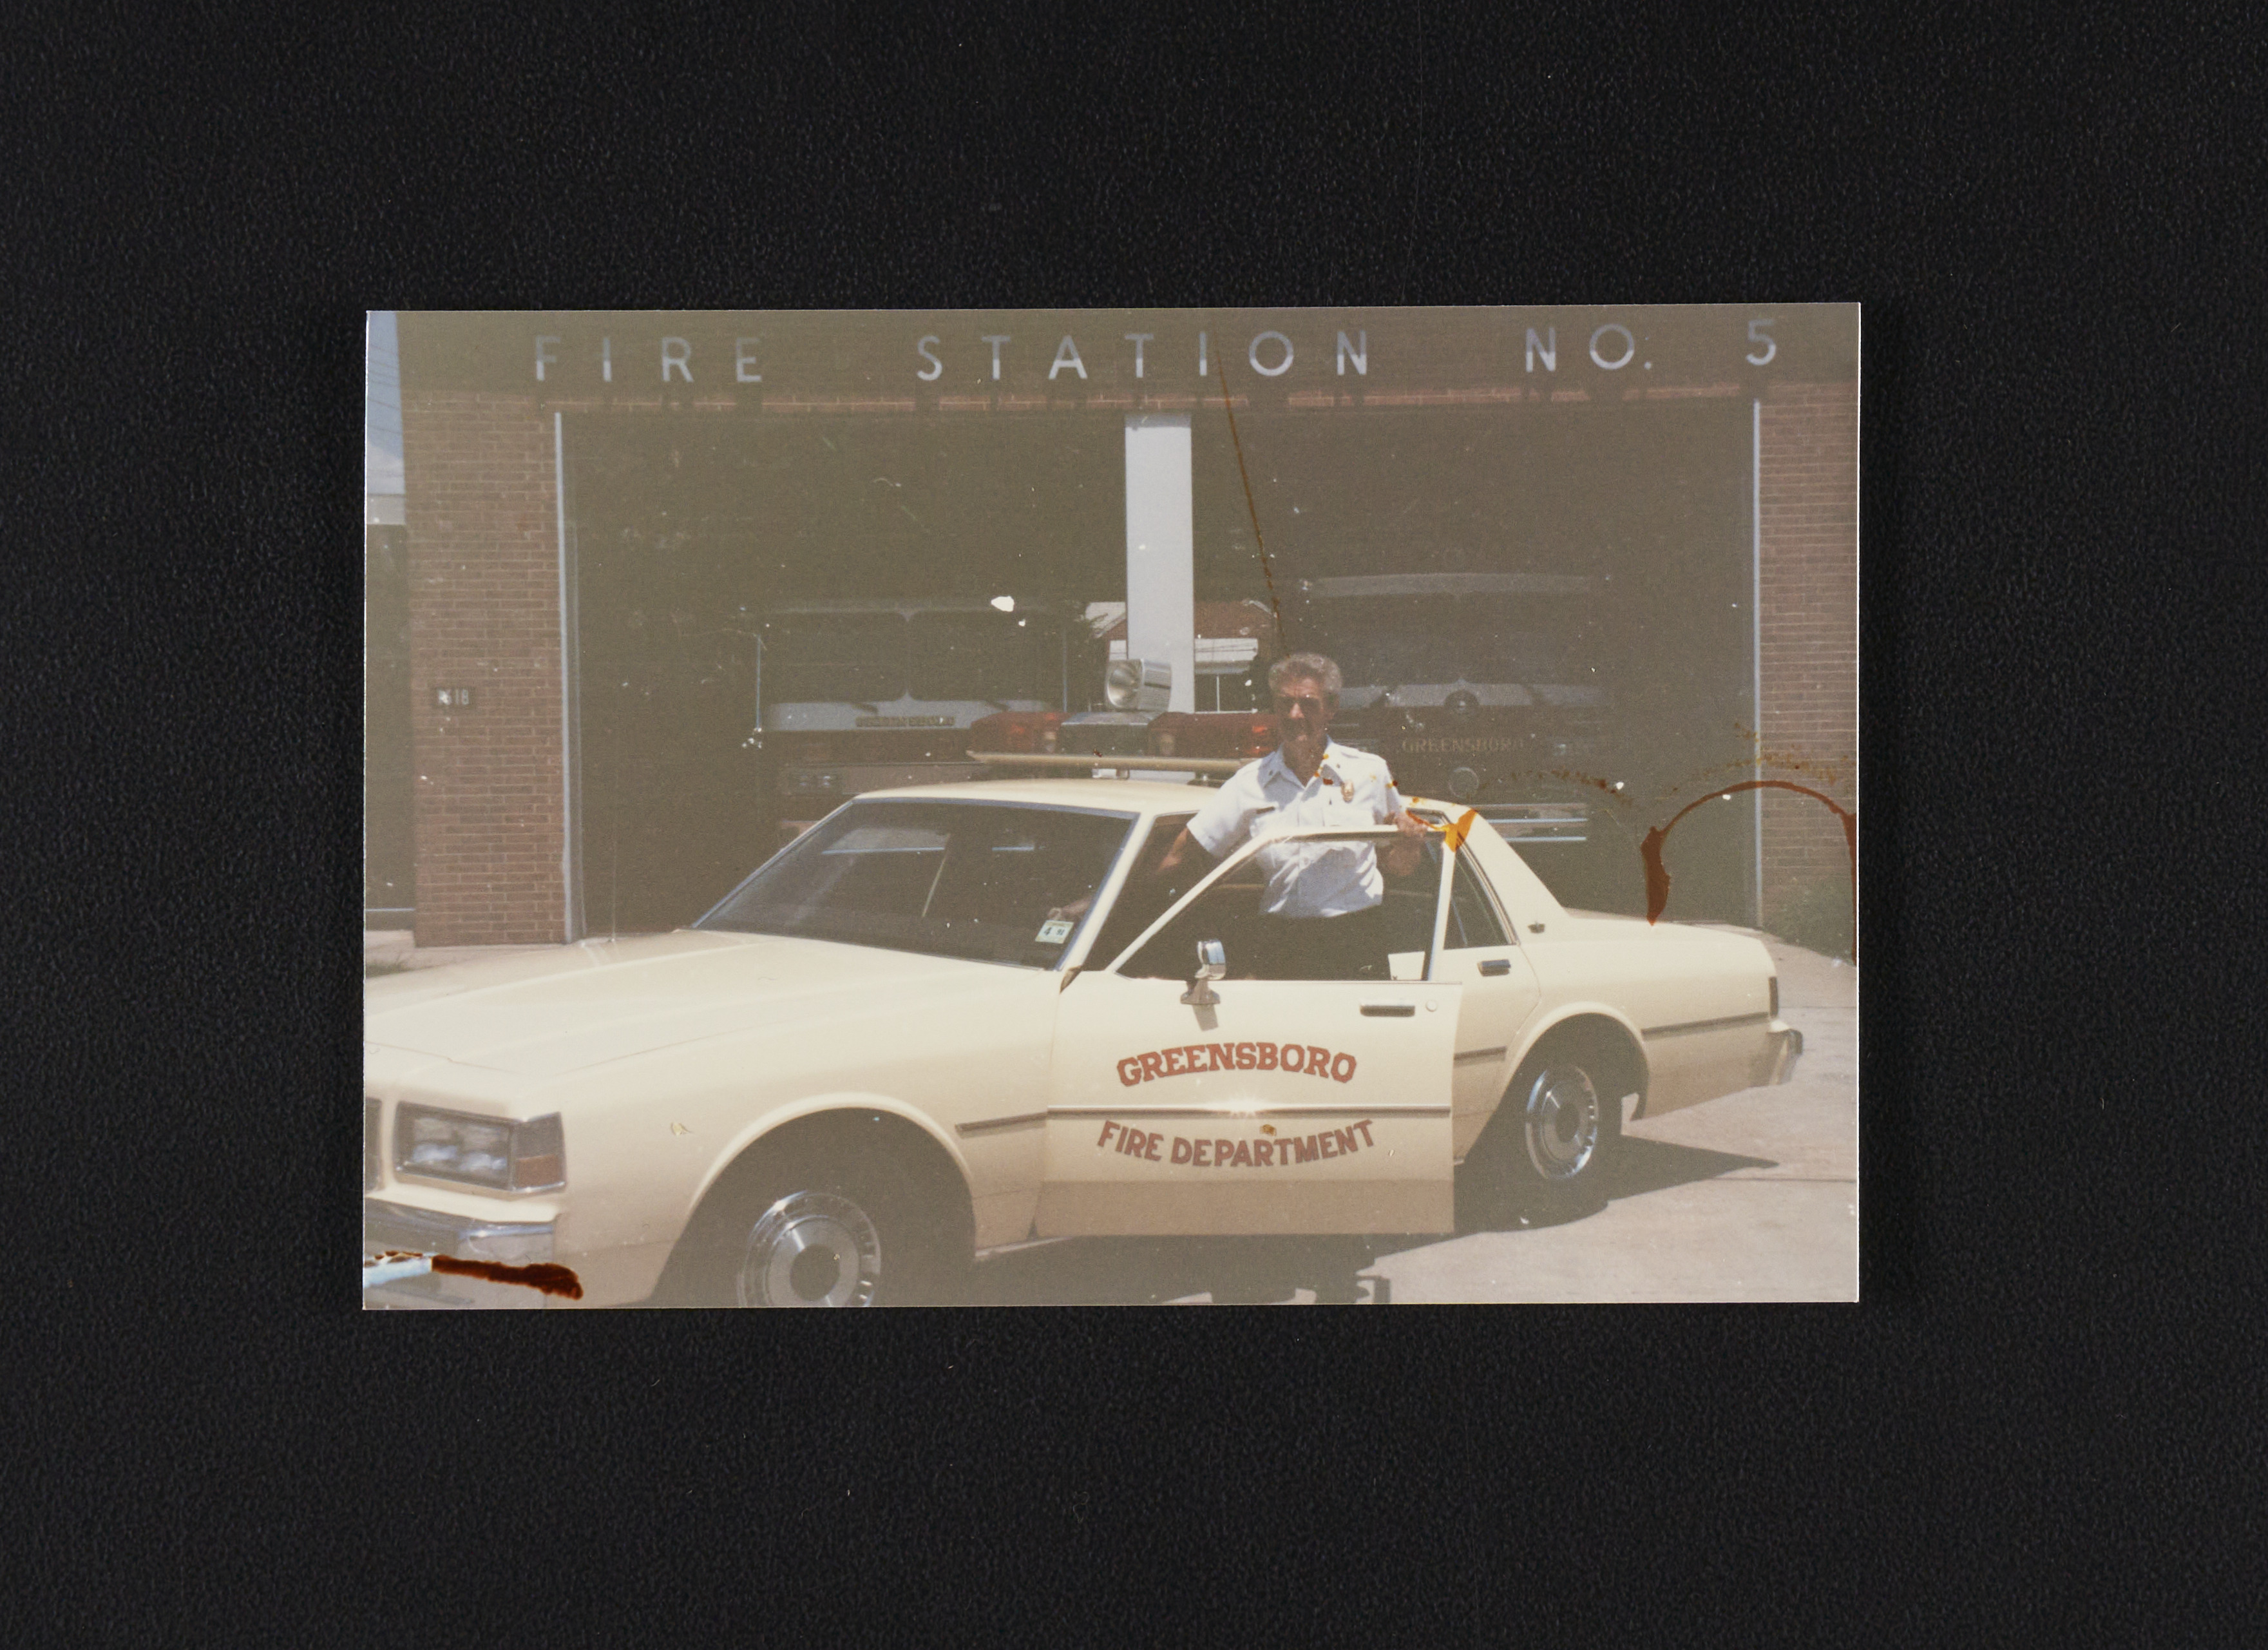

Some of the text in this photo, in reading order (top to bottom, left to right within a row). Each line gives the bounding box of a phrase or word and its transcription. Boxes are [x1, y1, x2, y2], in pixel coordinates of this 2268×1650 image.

[534, 319, 1777, 382] FIRE STATION NO. 5
[1116, 1042, 1357, 1088] GREENSBORO
[1097, 1118, 1375, 1167] FIRE DEPARTMENT
